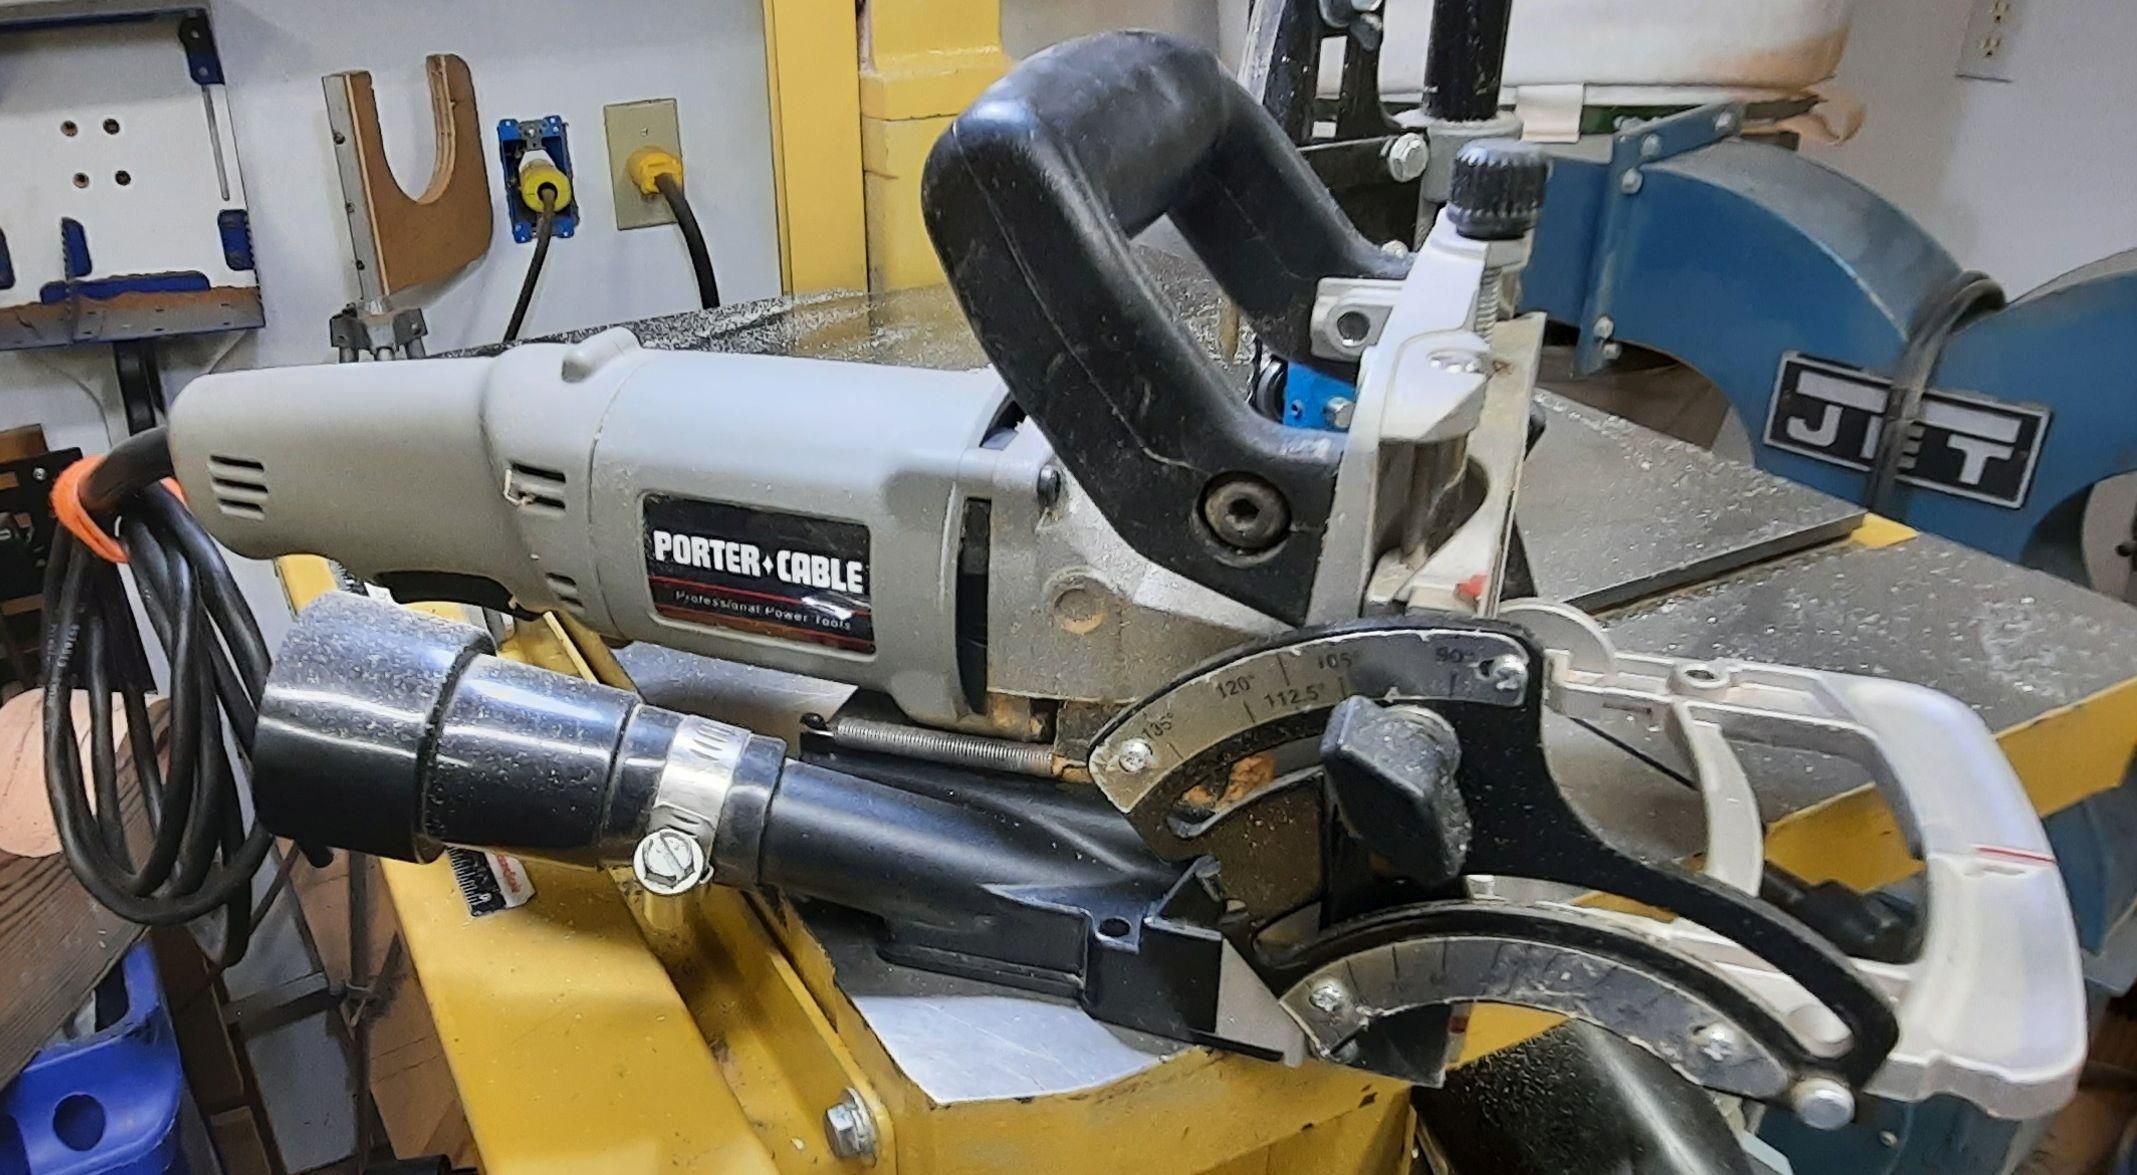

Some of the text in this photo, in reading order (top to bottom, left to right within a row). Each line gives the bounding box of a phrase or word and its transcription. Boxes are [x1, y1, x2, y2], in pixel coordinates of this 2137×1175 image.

[1786, 371, 2022, 485] JET
[653, 530, 864, 593] PORTER CABLE
[675, 590, 851, 630] Professional Power Tools
